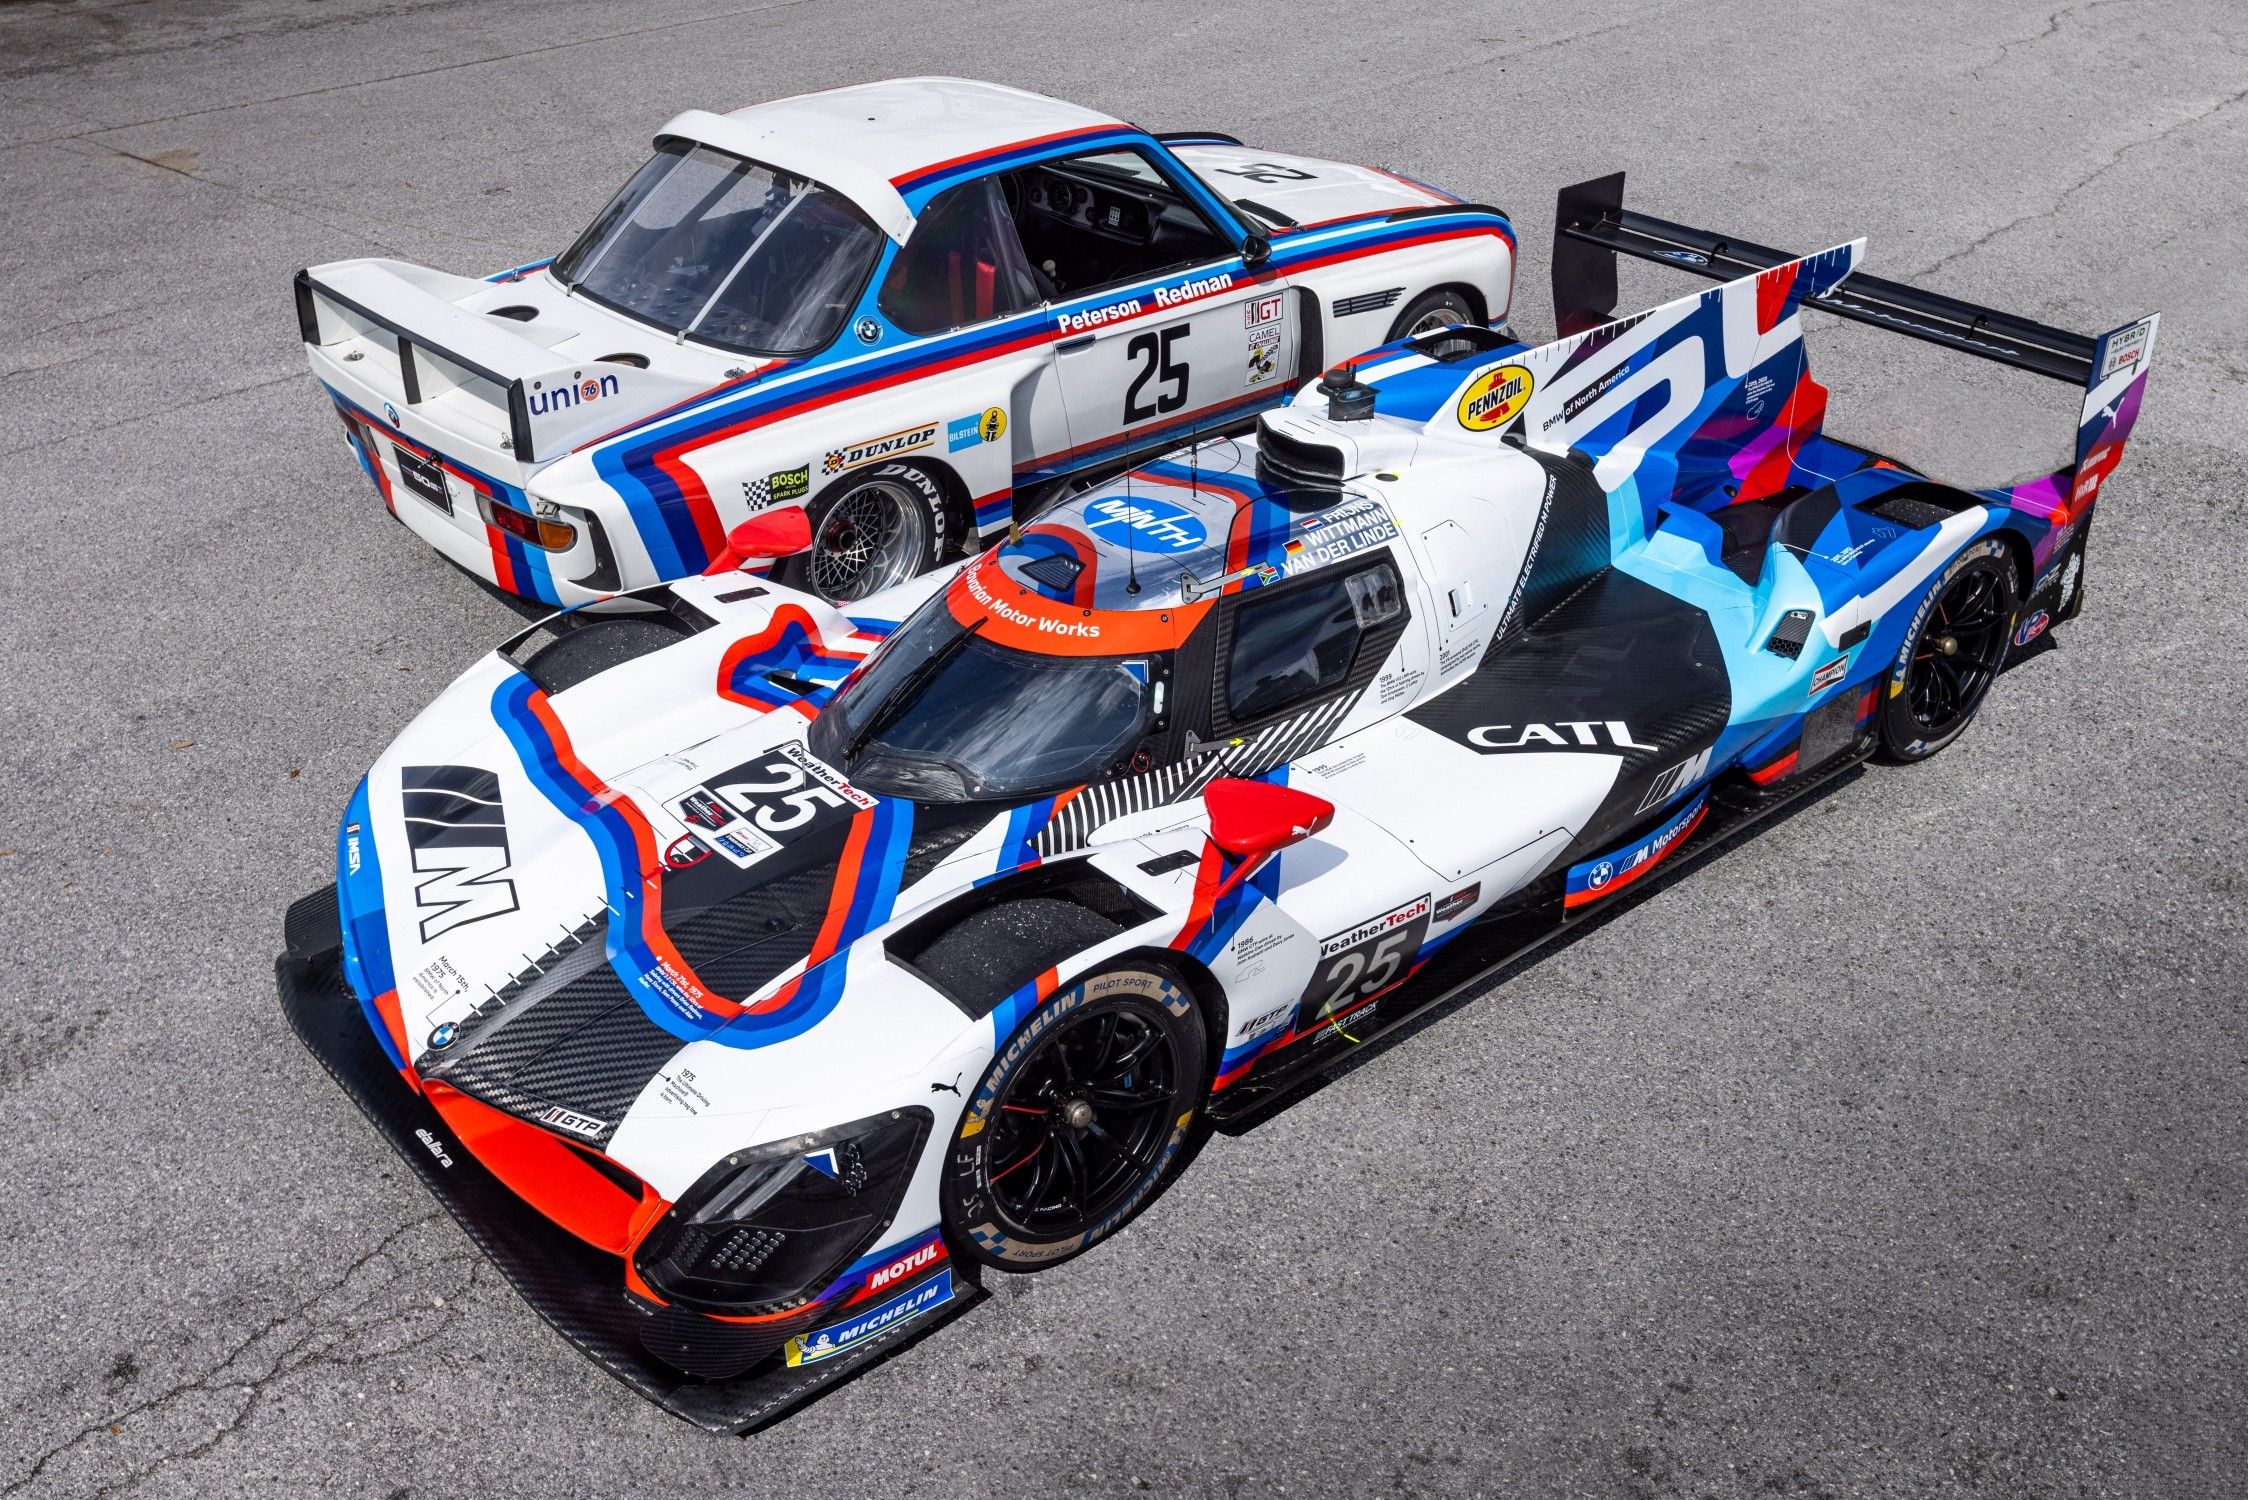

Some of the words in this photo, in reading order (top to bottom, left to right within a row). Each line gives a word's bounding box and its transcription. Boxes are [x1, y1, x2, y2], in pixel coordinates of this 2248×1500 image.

[1058, 298, 1142, 334] Peterson
[1153, 273, 1233, 307] Redman
[1260, 298, 1281, 320] GT
[1249, 327, 1280, 343] CAMEL
[2111, 327, 2146, 348] HYBRID
[1123, 323, 1190, 425] 25
[2118, 348, 2140, 365] BOSCH
[584, 384, 597, 397] 76
[1467, 376, 1524, 421] PENNZOIL
[1543, 410, 1564, 432] BMW
[1564, 402, 1574, 416] of
[1574, 388, 1597, 409] North
[1598, 366, 1630, 393] America
[848, 429, 935, 464] DUNLOP
[949, 427, 979, 443] BILSTEIN
[771, 469, 808, 489] BOSCH
[773, 489, 791, 500] SPARK
[791, 486, 809, 495] PLUGS
[1543, 474, 1557, 513] POWER
[873, 464, 945, 562] DUNLOP
[1305, 508, 1389, 546] WITTMANN
[1321, 501, 1374, 523] FRIJNS
[1540, 511, 1549, 524] M
[1281, 554, 1317, 576] VAN
[1316, 540, 1351, 562] DER
[1351, 521, 1397, 549] LINDE
[1520, 522, 1545, 589] ELECTRIFIED
[966, 563, 993, 605] Bavarian
[988, 598, 1037, 627] Motor
[1038, 616, 1100, 637] Works
[1496, 585, 1522, 641] ULTIMATE
[1898, 577, 1942, 664] MICHELIN
[1813, 663, 1846, 686] CHAMPION
[787, 747, 869, 807] WeatherTech
[714, 763, 847, 832] 25
[1652, 798, 1704, 855] Motorsport
[348, 836, 361, 877] IMSA
[1237, 936, 1254, 949] 1986
[418, 972, 434, 990] America
[424, 967, 435, 980] BMW
[438, 984, 449, 996] North
[430, 962, 447, 979] 1975
[438, 956, 457, 977] March
[456, 975, 470, 992] 15th,
[660, 961, 679, 977] March
[688, 985, 704, 999] 1975
[1093, 979, 1122, 993] PILOT
[1122, 977, 1154, 990] SPORT
[1315, 929, 1408, 1021] 25
[1256, 1004, 1288, 1026] GTP
[1349, 1000, 1379, 1021] TRACK
[986, 993, 1076, 1093] MICHELIN
[681, 1068, 697, 1082] 1975
[682, 1081, 698, 1095] Ultimate
[696, 1092, 711, 1107] Driving
[560, 1115, 600, 1131] GTP
[415, 1128, 454, 1169] dallara
[1040, 1203, 1062, 1211] RACING
[1089, 1155, 1171, 1243] MICHELIN
[870, 1245, 938, 1290] MOTUL
[838, 1284, 939, 1343] MICHELIN
